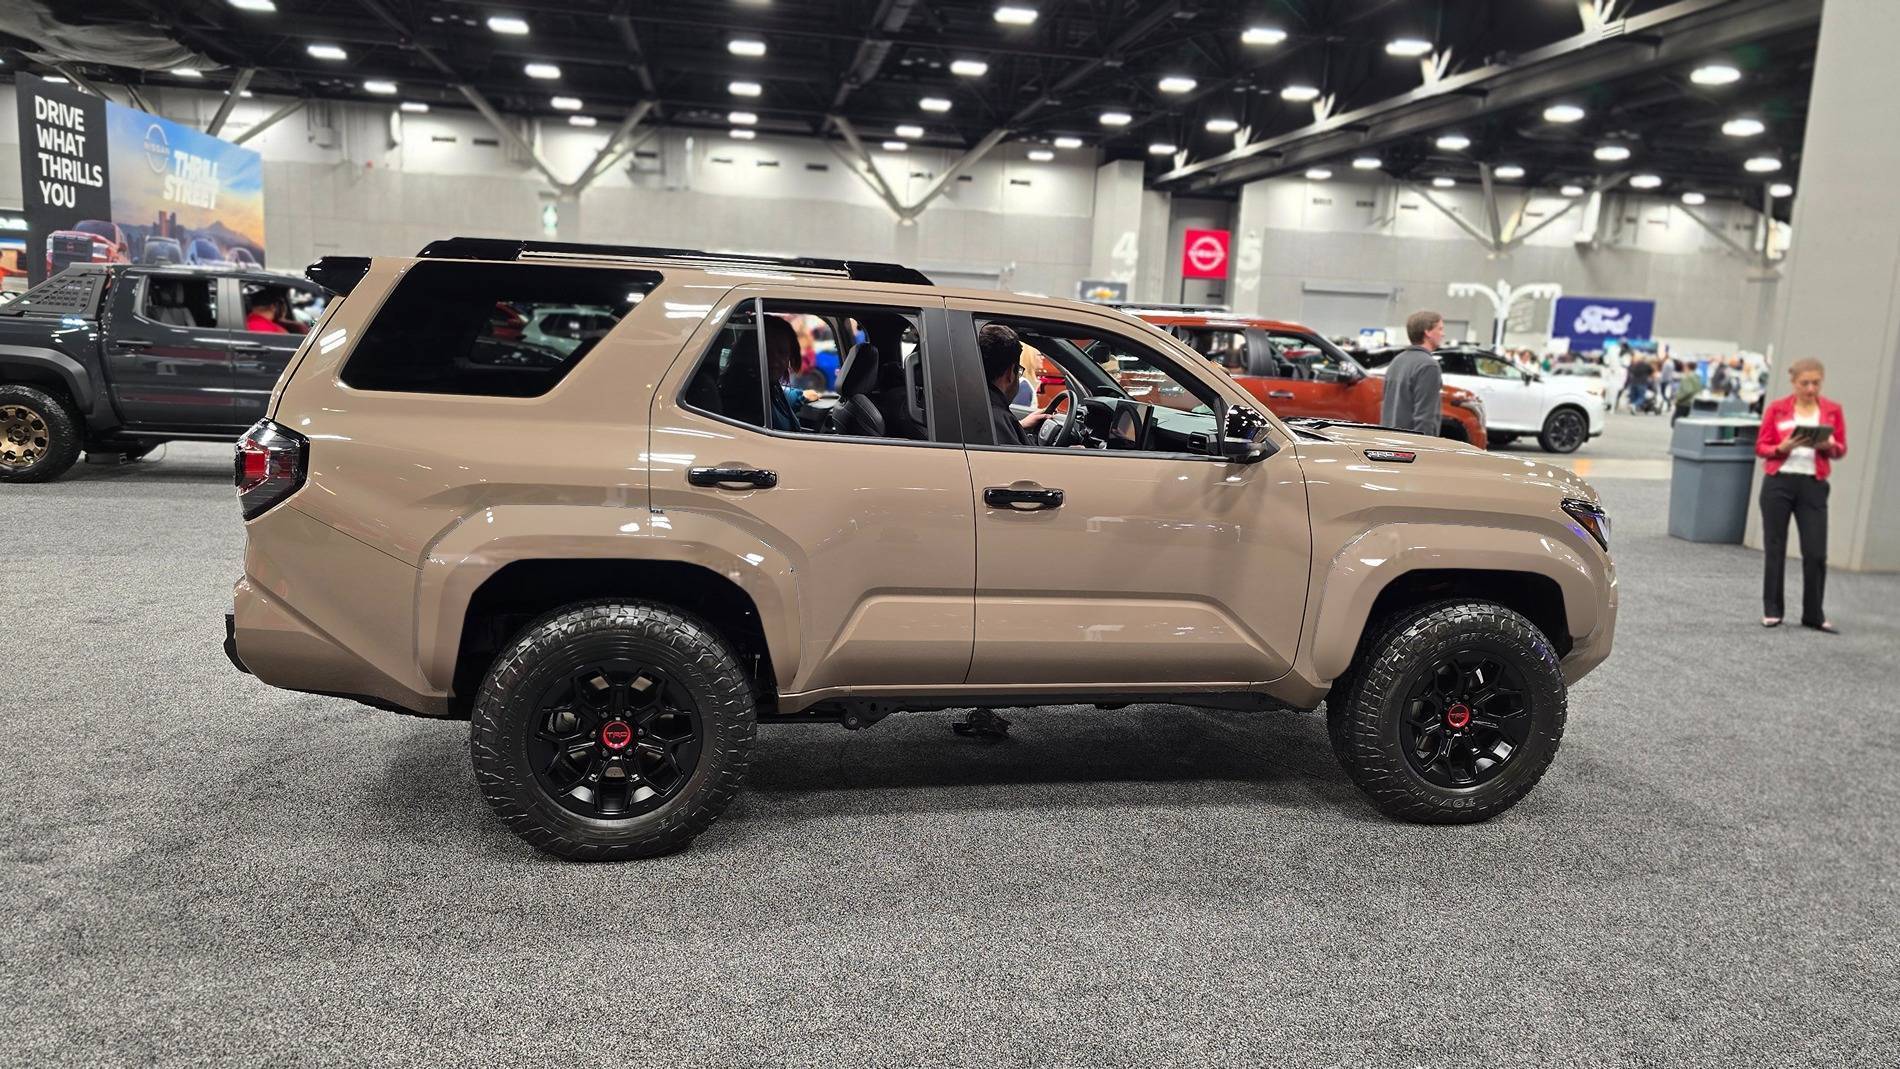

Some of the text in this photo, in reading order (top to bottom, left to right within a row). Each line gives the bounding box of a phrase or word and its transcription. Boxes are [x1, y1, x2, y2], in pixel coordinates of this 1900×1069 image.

[34, 95, 85, 132] DRIVE
[37, 124, 86, 158] WHAT
[38, 153, 103, 188] THRILLS
[174, 150, 218, 183] THRILL
[39, 181, 76, 208] YOU
[163, 174, 220, 210] STREET
[1111, 231, 1138, 266] 4
[1237, 236, 1262, 271] 5
[1573, 305, 1632, 335] Ford
[606, 731, 628, 739] TRD
